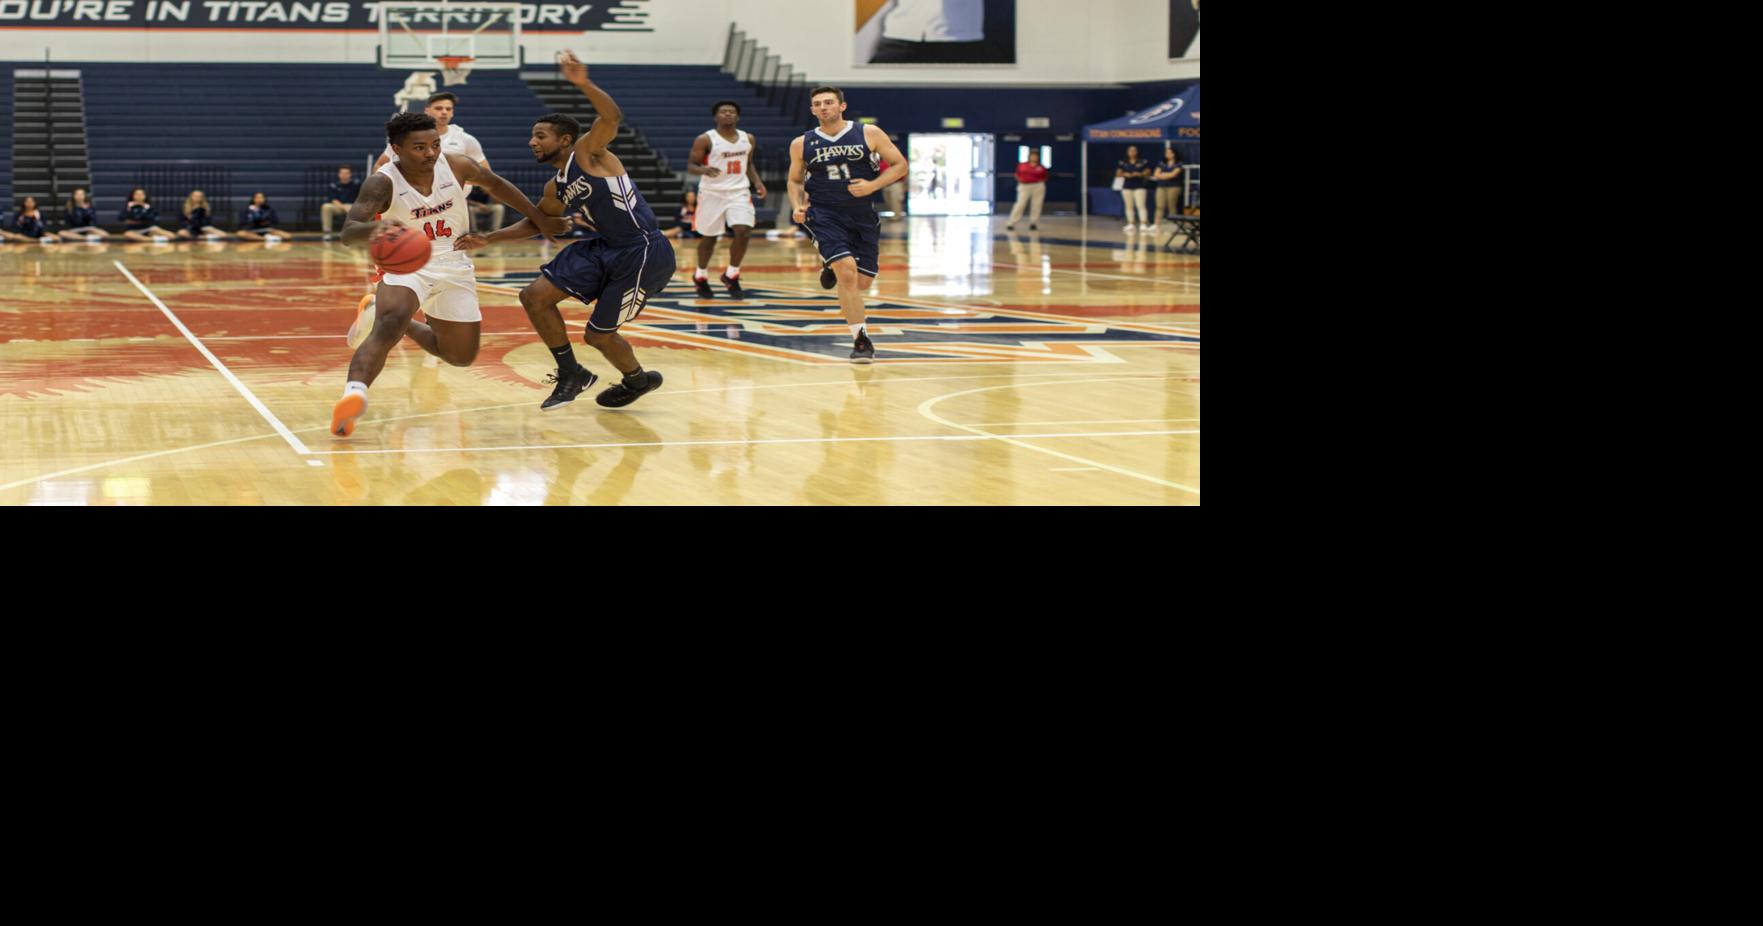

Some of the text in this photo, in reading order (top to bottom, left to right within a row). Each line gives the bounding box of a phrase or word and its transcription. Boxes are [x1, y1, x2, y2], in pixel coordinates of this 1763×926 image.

[145, 1, 191, 21] IN
[203, 2, 350, 22] TITANS
[811, 145, 864, 164] HAWKS
[826, 163, 851, 180] 21
[411, 199, 453, 220] TITANS
